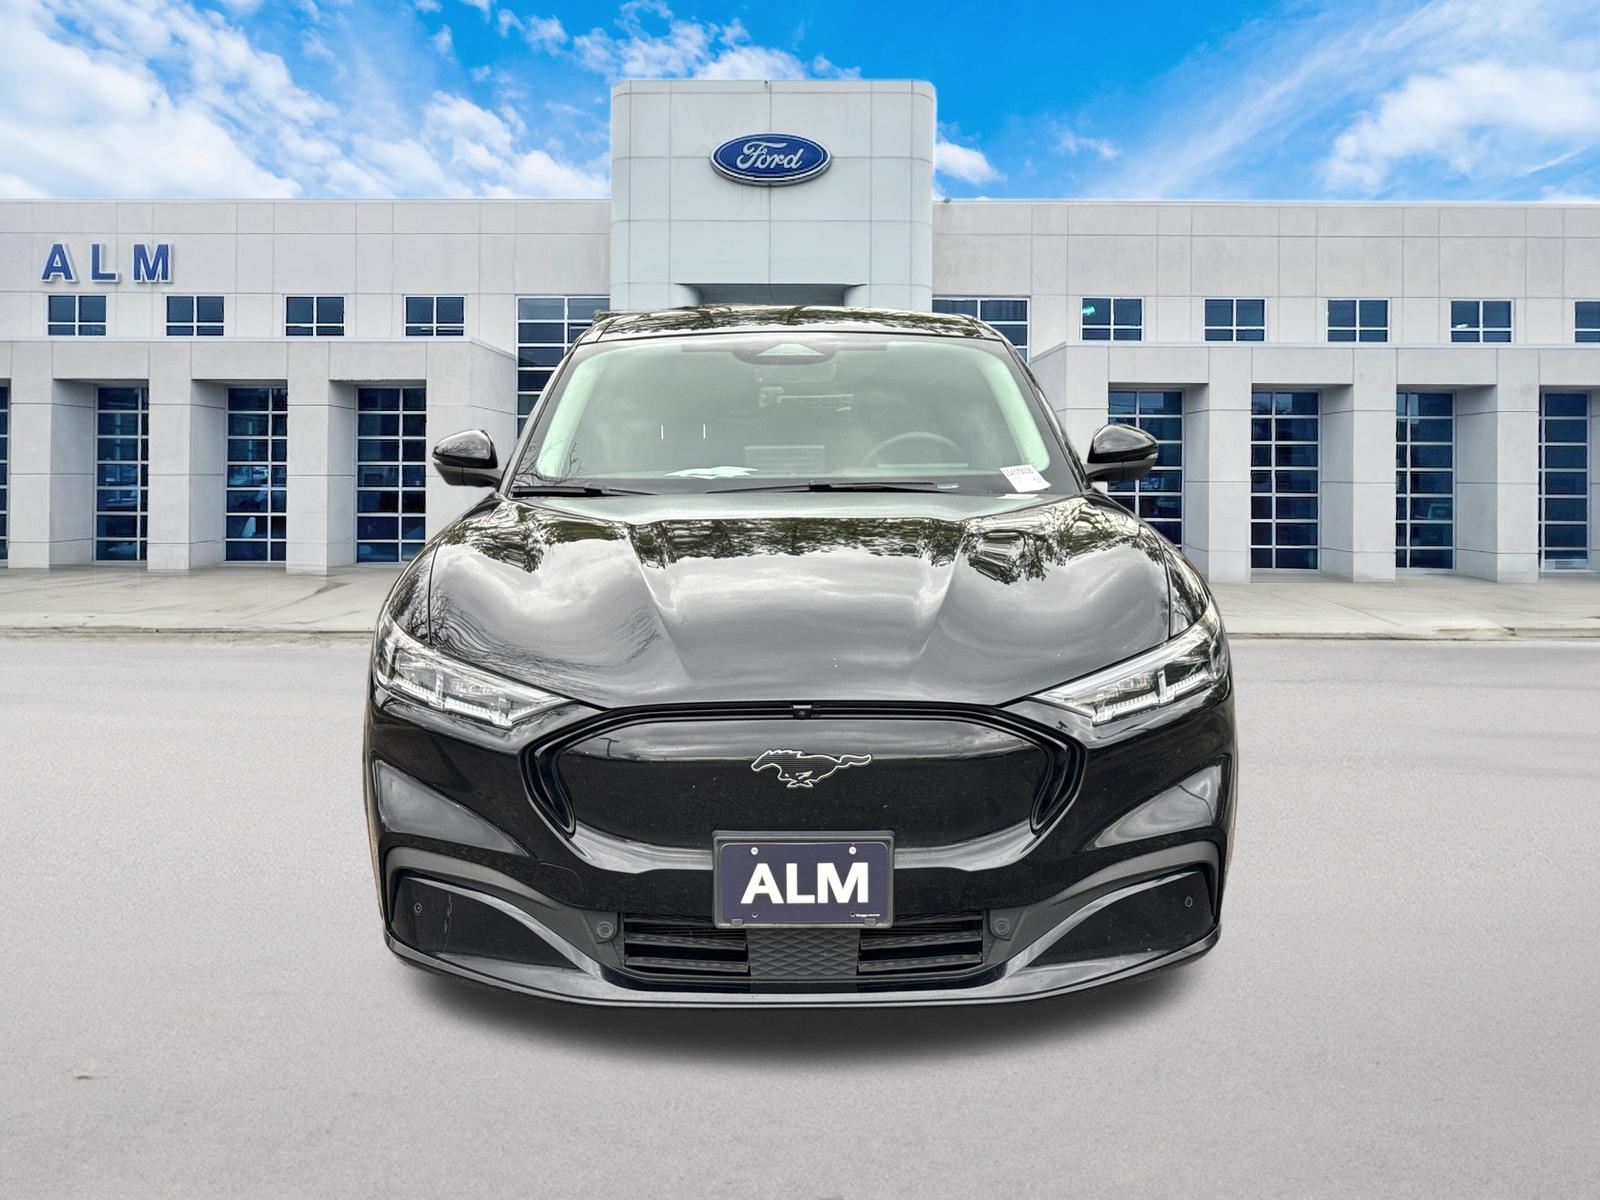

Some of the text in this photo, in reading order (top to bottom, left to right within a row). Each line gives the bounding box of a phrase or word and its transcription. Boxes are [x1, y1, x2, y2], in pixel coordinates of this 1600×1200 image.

[736, 141, 805, 170] Ford
[41, 243, 173, 282] ALM
[740, 862, 869, 904] ALM
